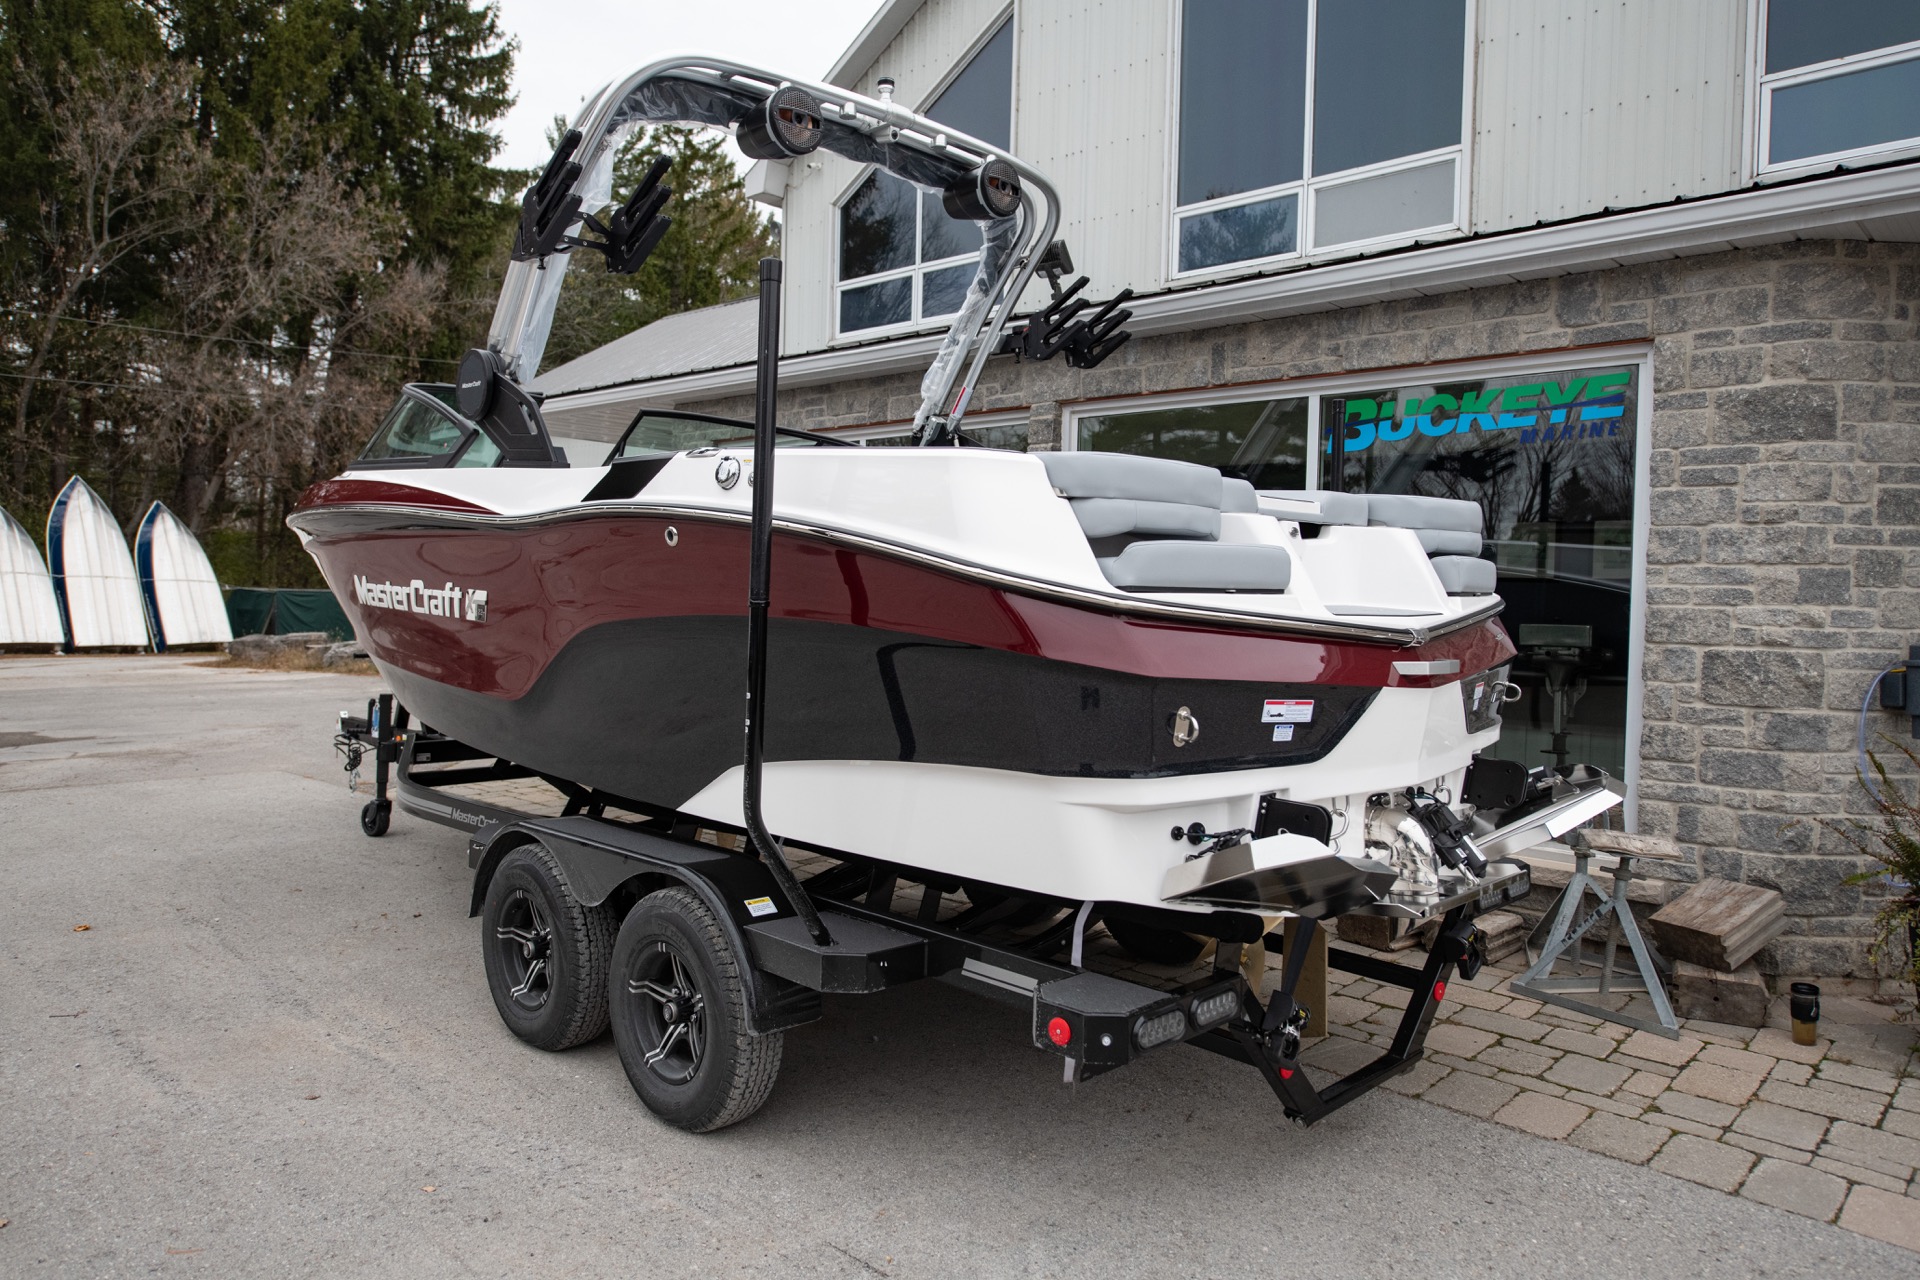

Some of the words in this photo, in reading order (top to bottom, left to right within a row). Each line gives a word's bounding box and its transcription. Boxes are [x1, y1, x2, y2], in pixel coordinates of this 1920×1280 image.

[1326, 372, 1631, 454] BUCKEYE
[1520, 420, 1621, 444] MARINE
[354, 574, 462, 618] MasterCraft
[452, 808, 499, 827] MasterCr
